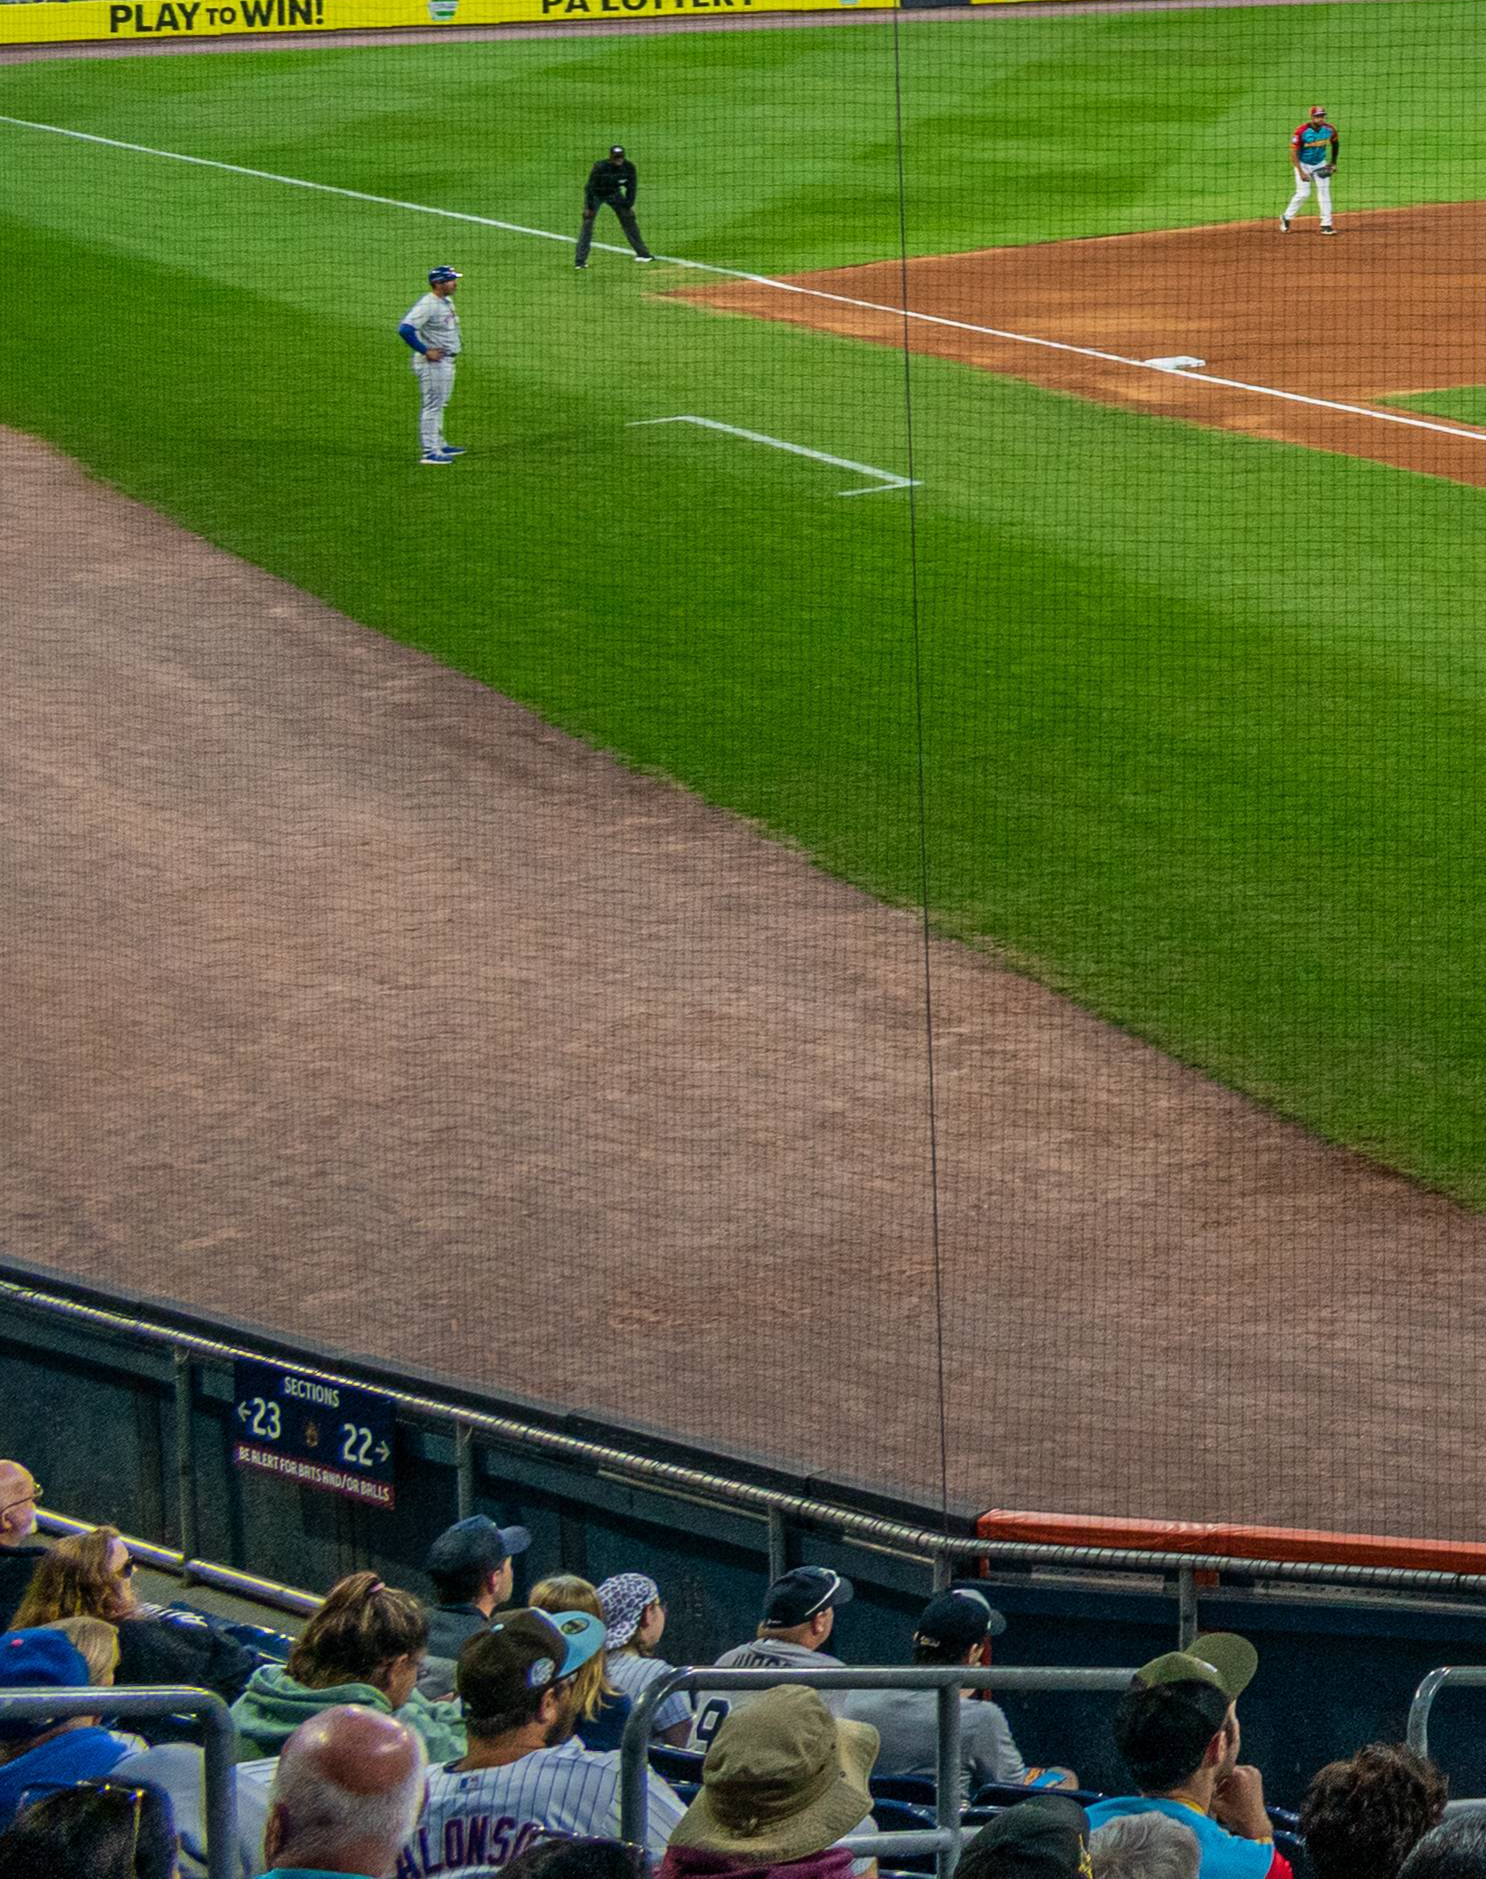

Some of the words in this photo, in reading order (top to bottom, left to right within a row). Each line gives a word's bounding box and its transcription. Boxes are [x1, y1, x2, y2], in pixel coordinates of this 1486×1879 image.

[109, 4, 201, 34] PLAY
[206, 6, 237, 27] TO
[284, 1376, 340, 1409] SECTIONS
[252, 1396, 281, 1440] 23
[343, 1423, 373, 1467] 22
